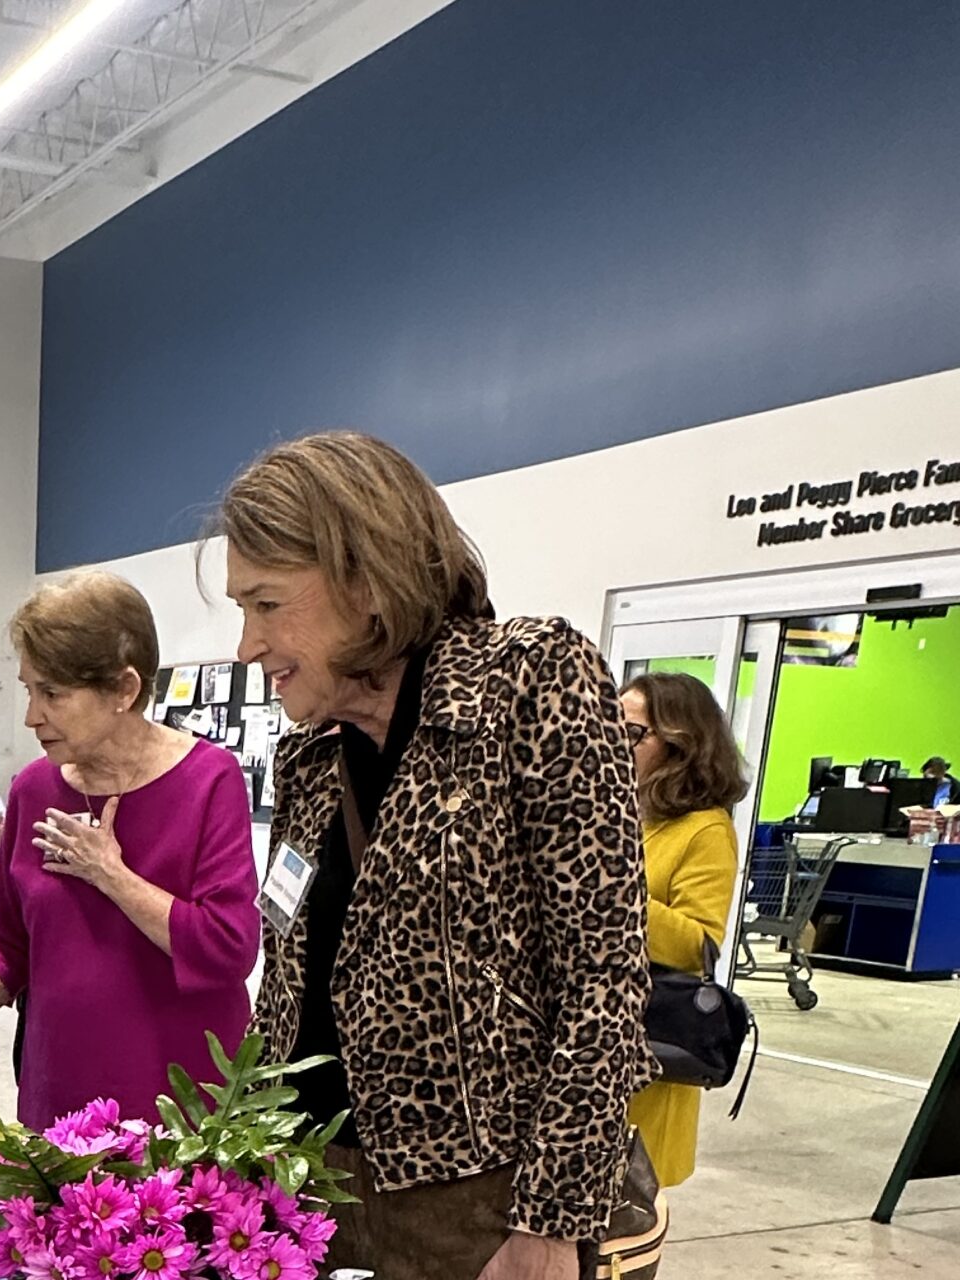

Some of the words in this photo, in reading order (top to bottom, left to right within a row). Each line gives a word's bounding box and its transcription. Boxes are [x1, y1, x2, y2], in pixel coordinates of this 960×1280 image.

[760, 484, 794, 512] and
[796, 481, 853, 509] Peggy
[857, 469, 919, 498] Pierce
[757, 517, 828, 547] Member
[831, 510, 886, 537] Share
